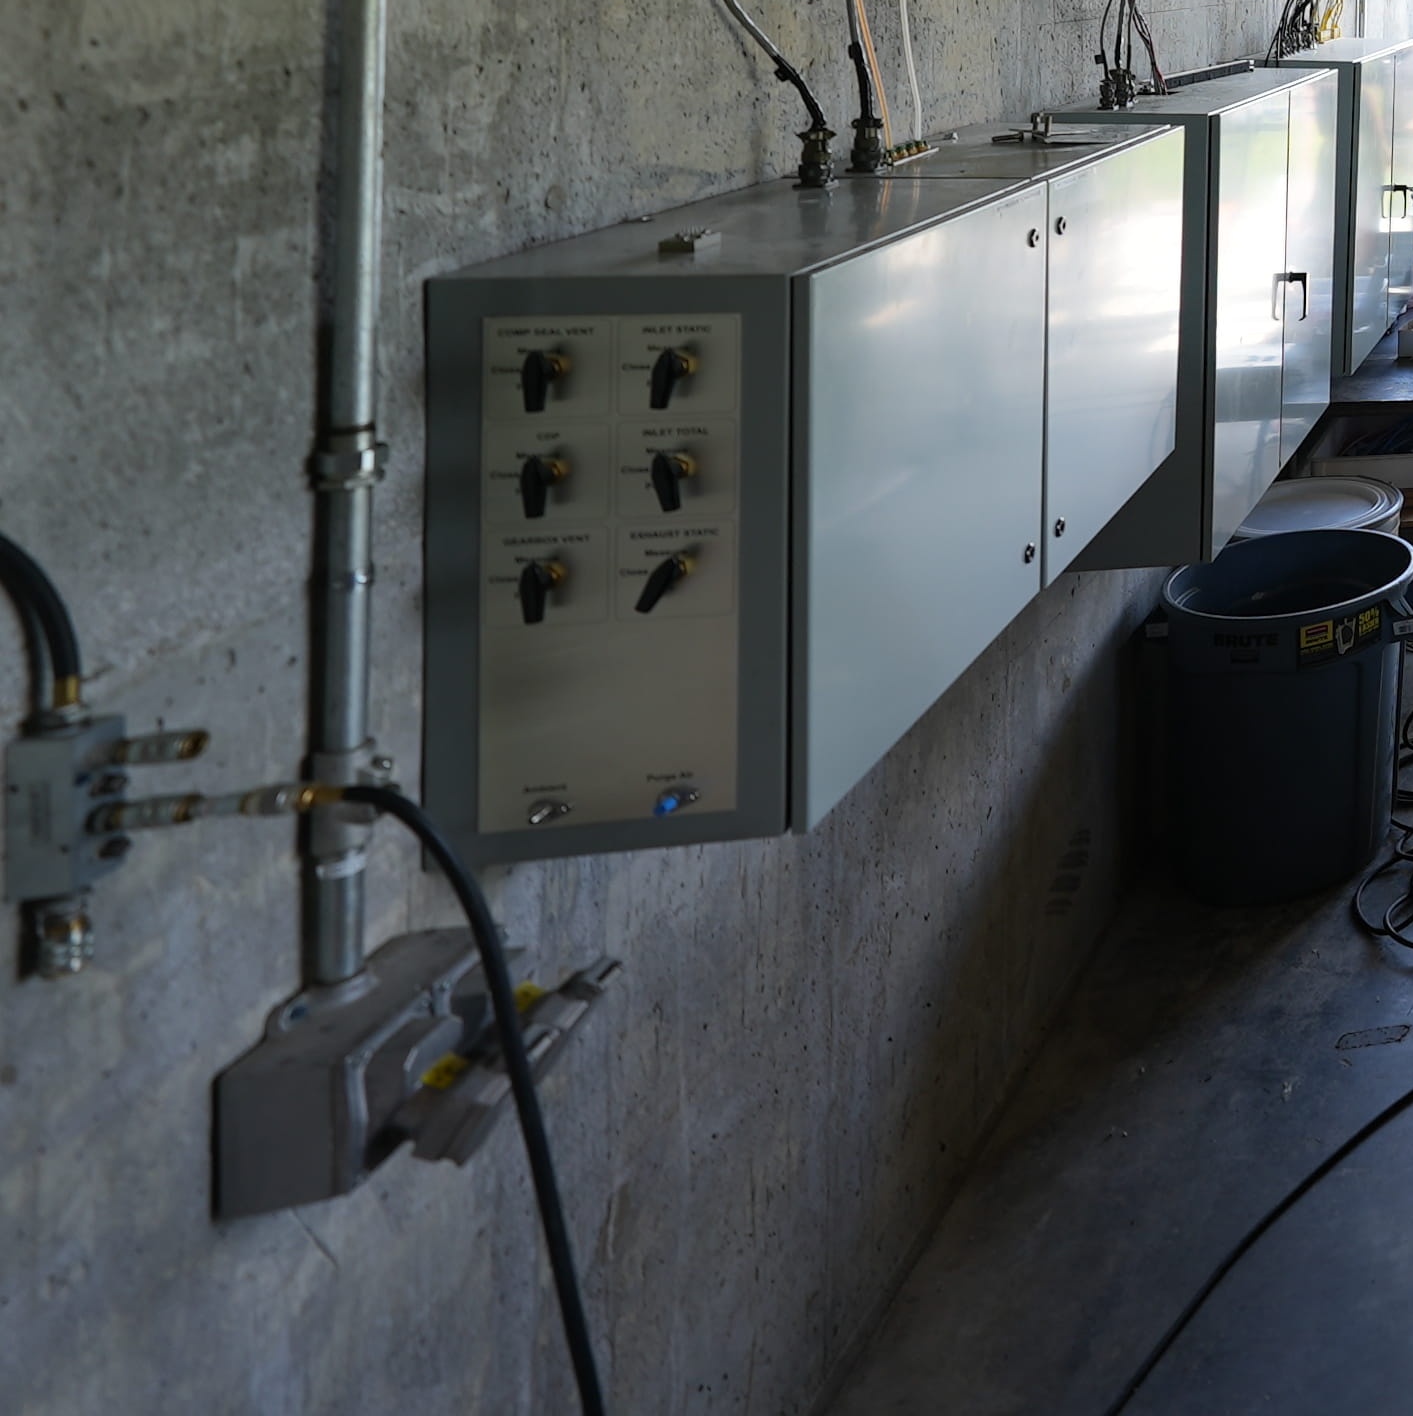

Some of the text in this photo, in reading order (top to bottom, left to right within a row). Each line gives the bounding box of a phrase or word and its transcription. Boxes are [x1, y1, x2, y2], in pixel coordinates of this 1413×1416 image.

[566, 327, 594, 335] VENT
[642, 325, 711, 334] INLET STATIC
[642, 427, 709, 436] INLET TOTAL
[630, 530, 680, 540] EXHAUST
[1214, 633, 1280, 647] BRUTE
